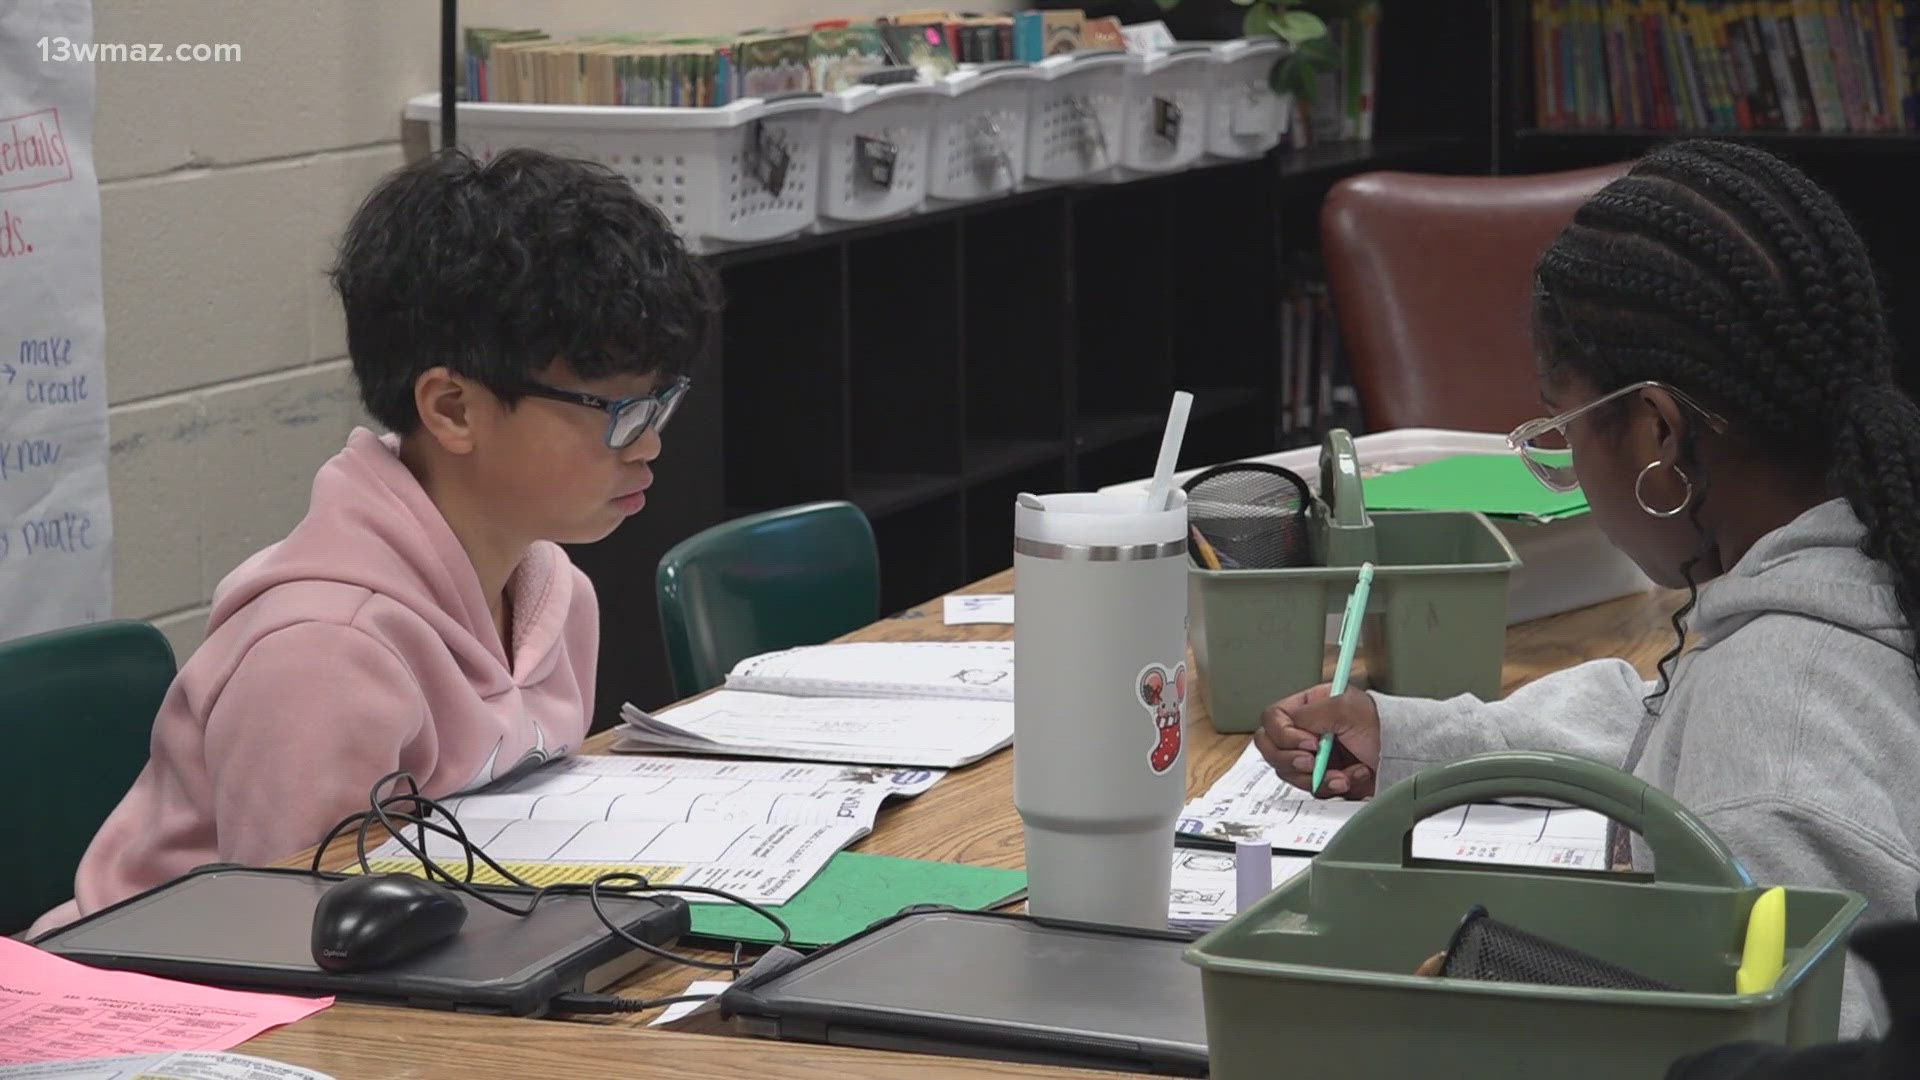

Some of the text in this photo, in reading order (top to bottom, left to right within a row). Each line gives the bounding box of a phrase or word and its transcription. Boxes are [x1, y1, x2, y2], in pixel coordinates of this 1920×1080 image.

[0, 121, 64, 176] etails
[20, 336, 72, 367] make
[26, 374, 88, 404] create
[22, 511, 92, 555] make
